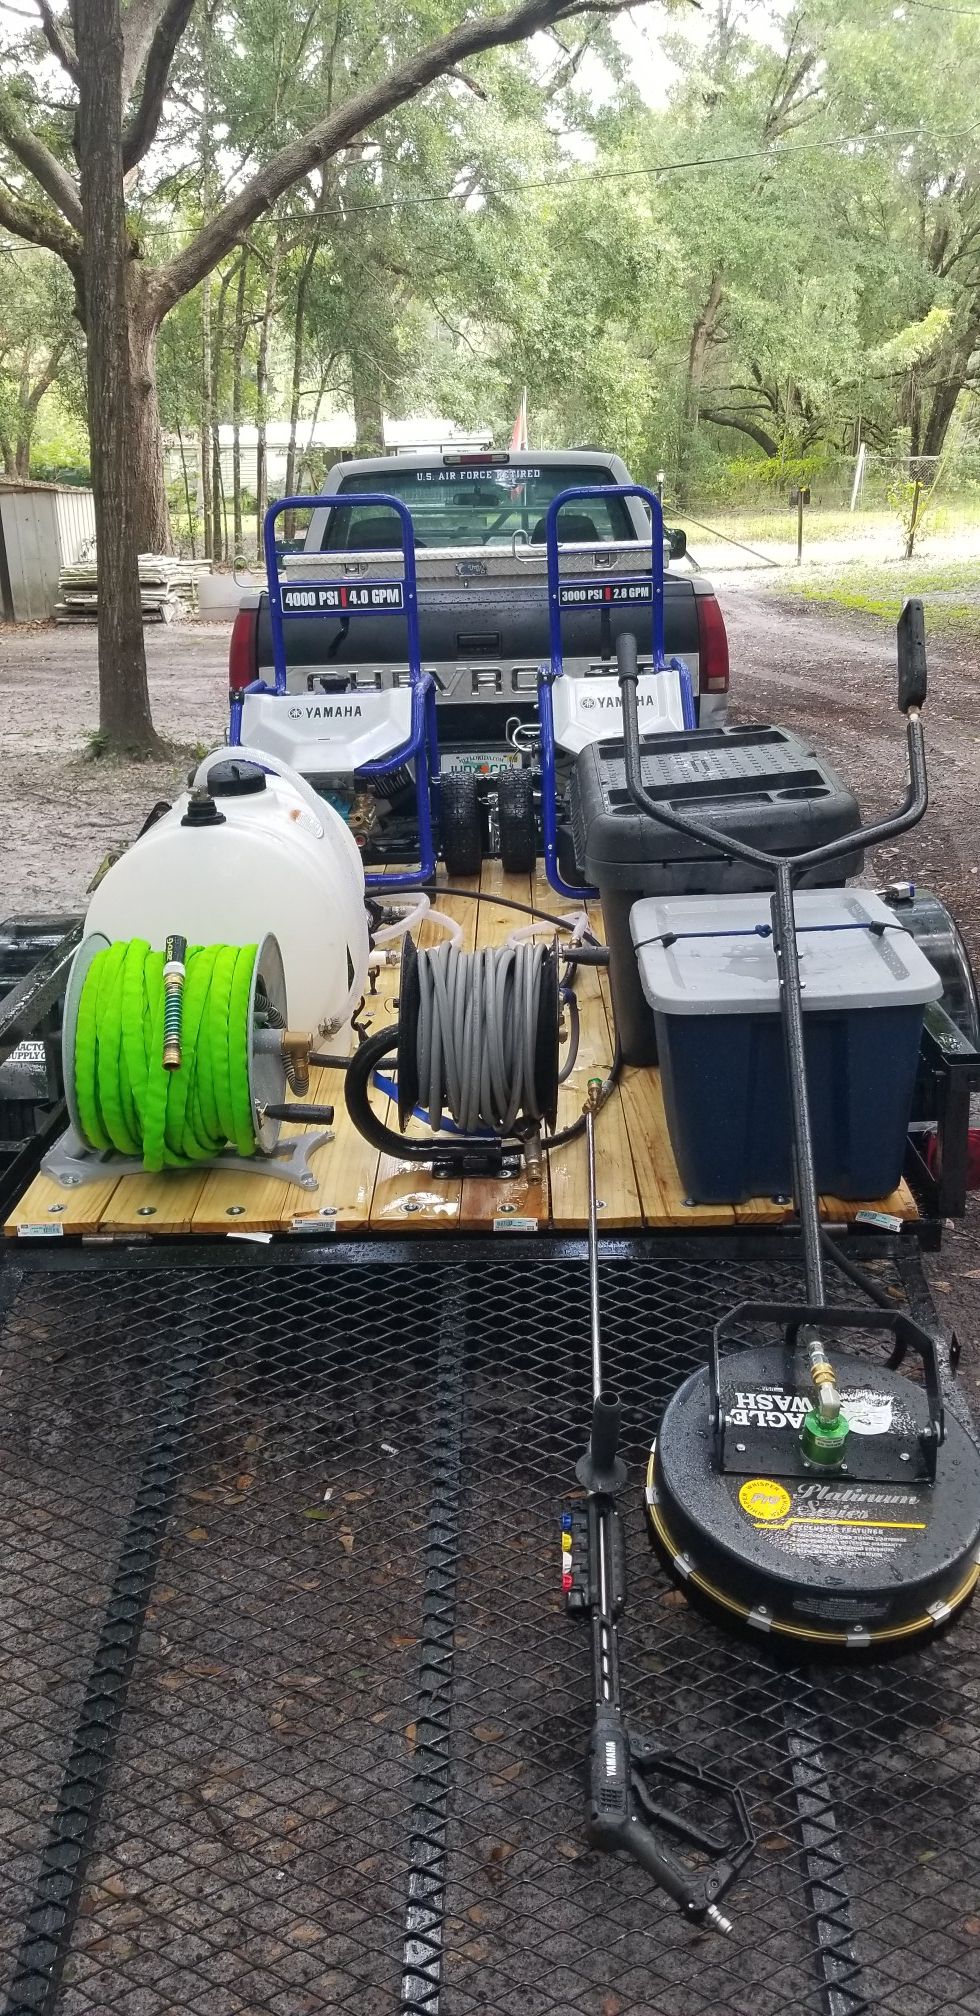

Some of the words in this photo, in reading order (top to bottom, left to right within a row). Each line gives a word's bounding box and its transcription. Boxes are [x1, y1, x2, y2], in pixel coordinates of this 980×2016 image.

[416, 472, 435, 481] U.S.
[438, 472, 456, 480] AIR
[460, 471, 492, 480] FORCE
[496, 469, 541, 479] RETIRED
[285, 591, 316, 607] 4000
[318, 591, 339, 606] PSI
[348, 589, 369, 605] 4.0
[371, 588, 400, 604] GPM
[561, 590, 586, 602] 3000
[587, 588, 603, 600] PSI
[613, 587, 627, 599] 2.8
[628, 586, 649, 598] GPM
[597, 694, 654, 709] YAMHA
[306, 705, 362, 719] YAMAHA
[735, 1392, 814, 1413] WASH
[730, 1408, 805, 1429] AGLE
[746, 1481, 780, 1491] WHISPER
[793, 1483, 920, 1505] Platinum
[750, 1492, 781, 1505] Pro
[796, 1500, 869, 1519] Series
[842, 1526, 884, 1535] FEATURES
[605, 1741, 617, 1777] YAMAHA
